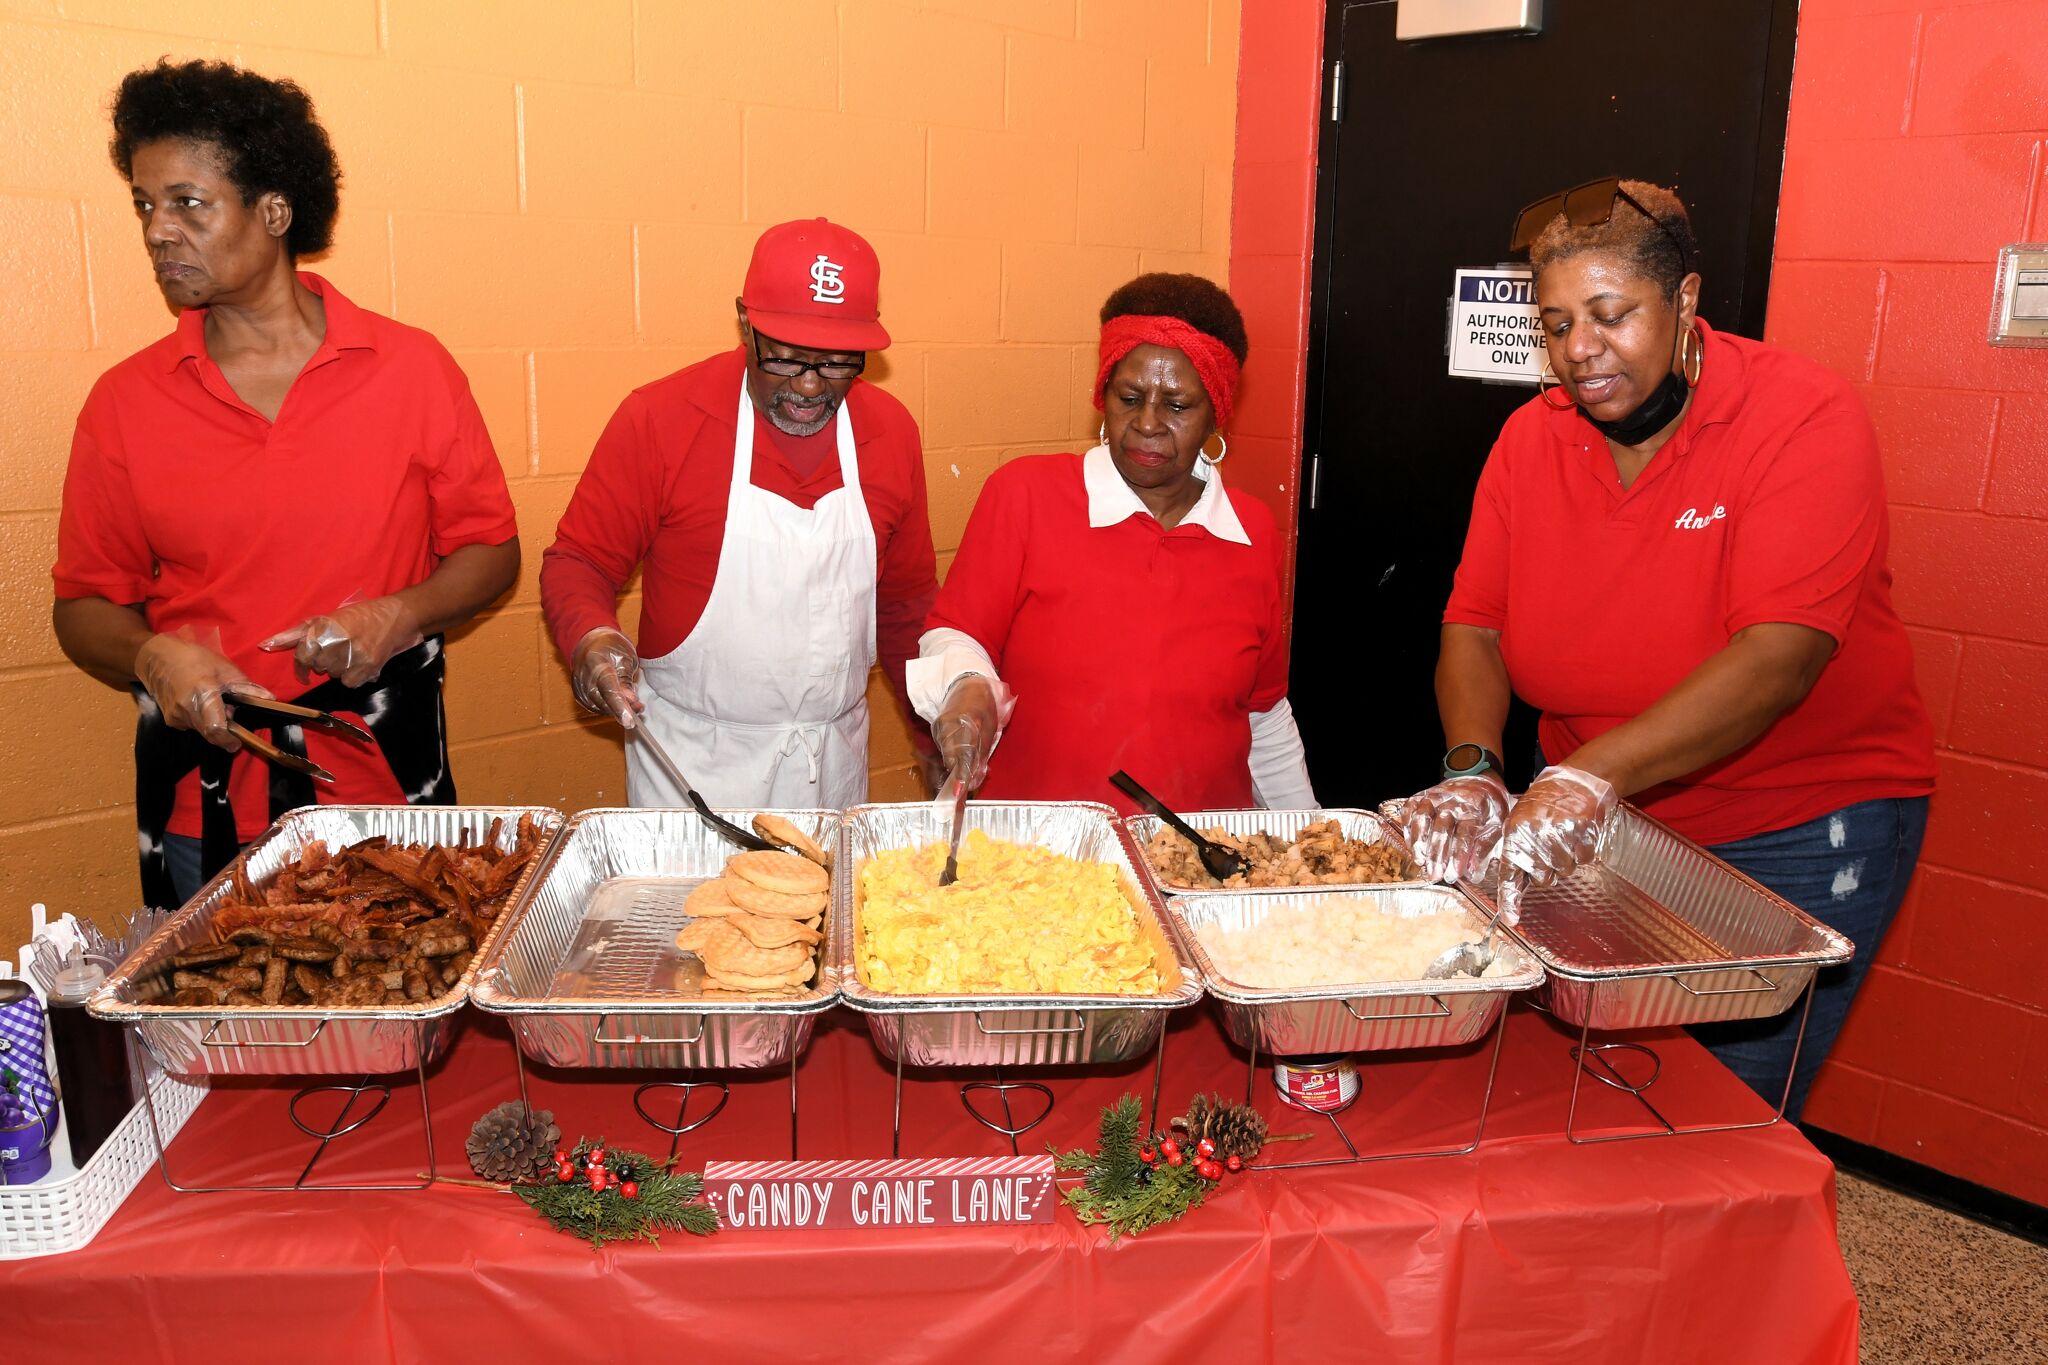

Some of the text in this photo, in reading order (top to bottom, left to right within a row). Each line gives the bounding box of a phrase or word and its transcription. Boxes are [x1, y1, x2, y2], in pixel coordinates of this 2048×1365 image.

[1477, 280, 1534, 303] NOTI
[1467, 314, 1542, 331] AUTHORIZ
[1470, 331, 1547, 348] PERSONNE
[1491, 350, 1530, 365] ONLY
[727, 1177, 1033, 1227] CANDY CANE LANE
